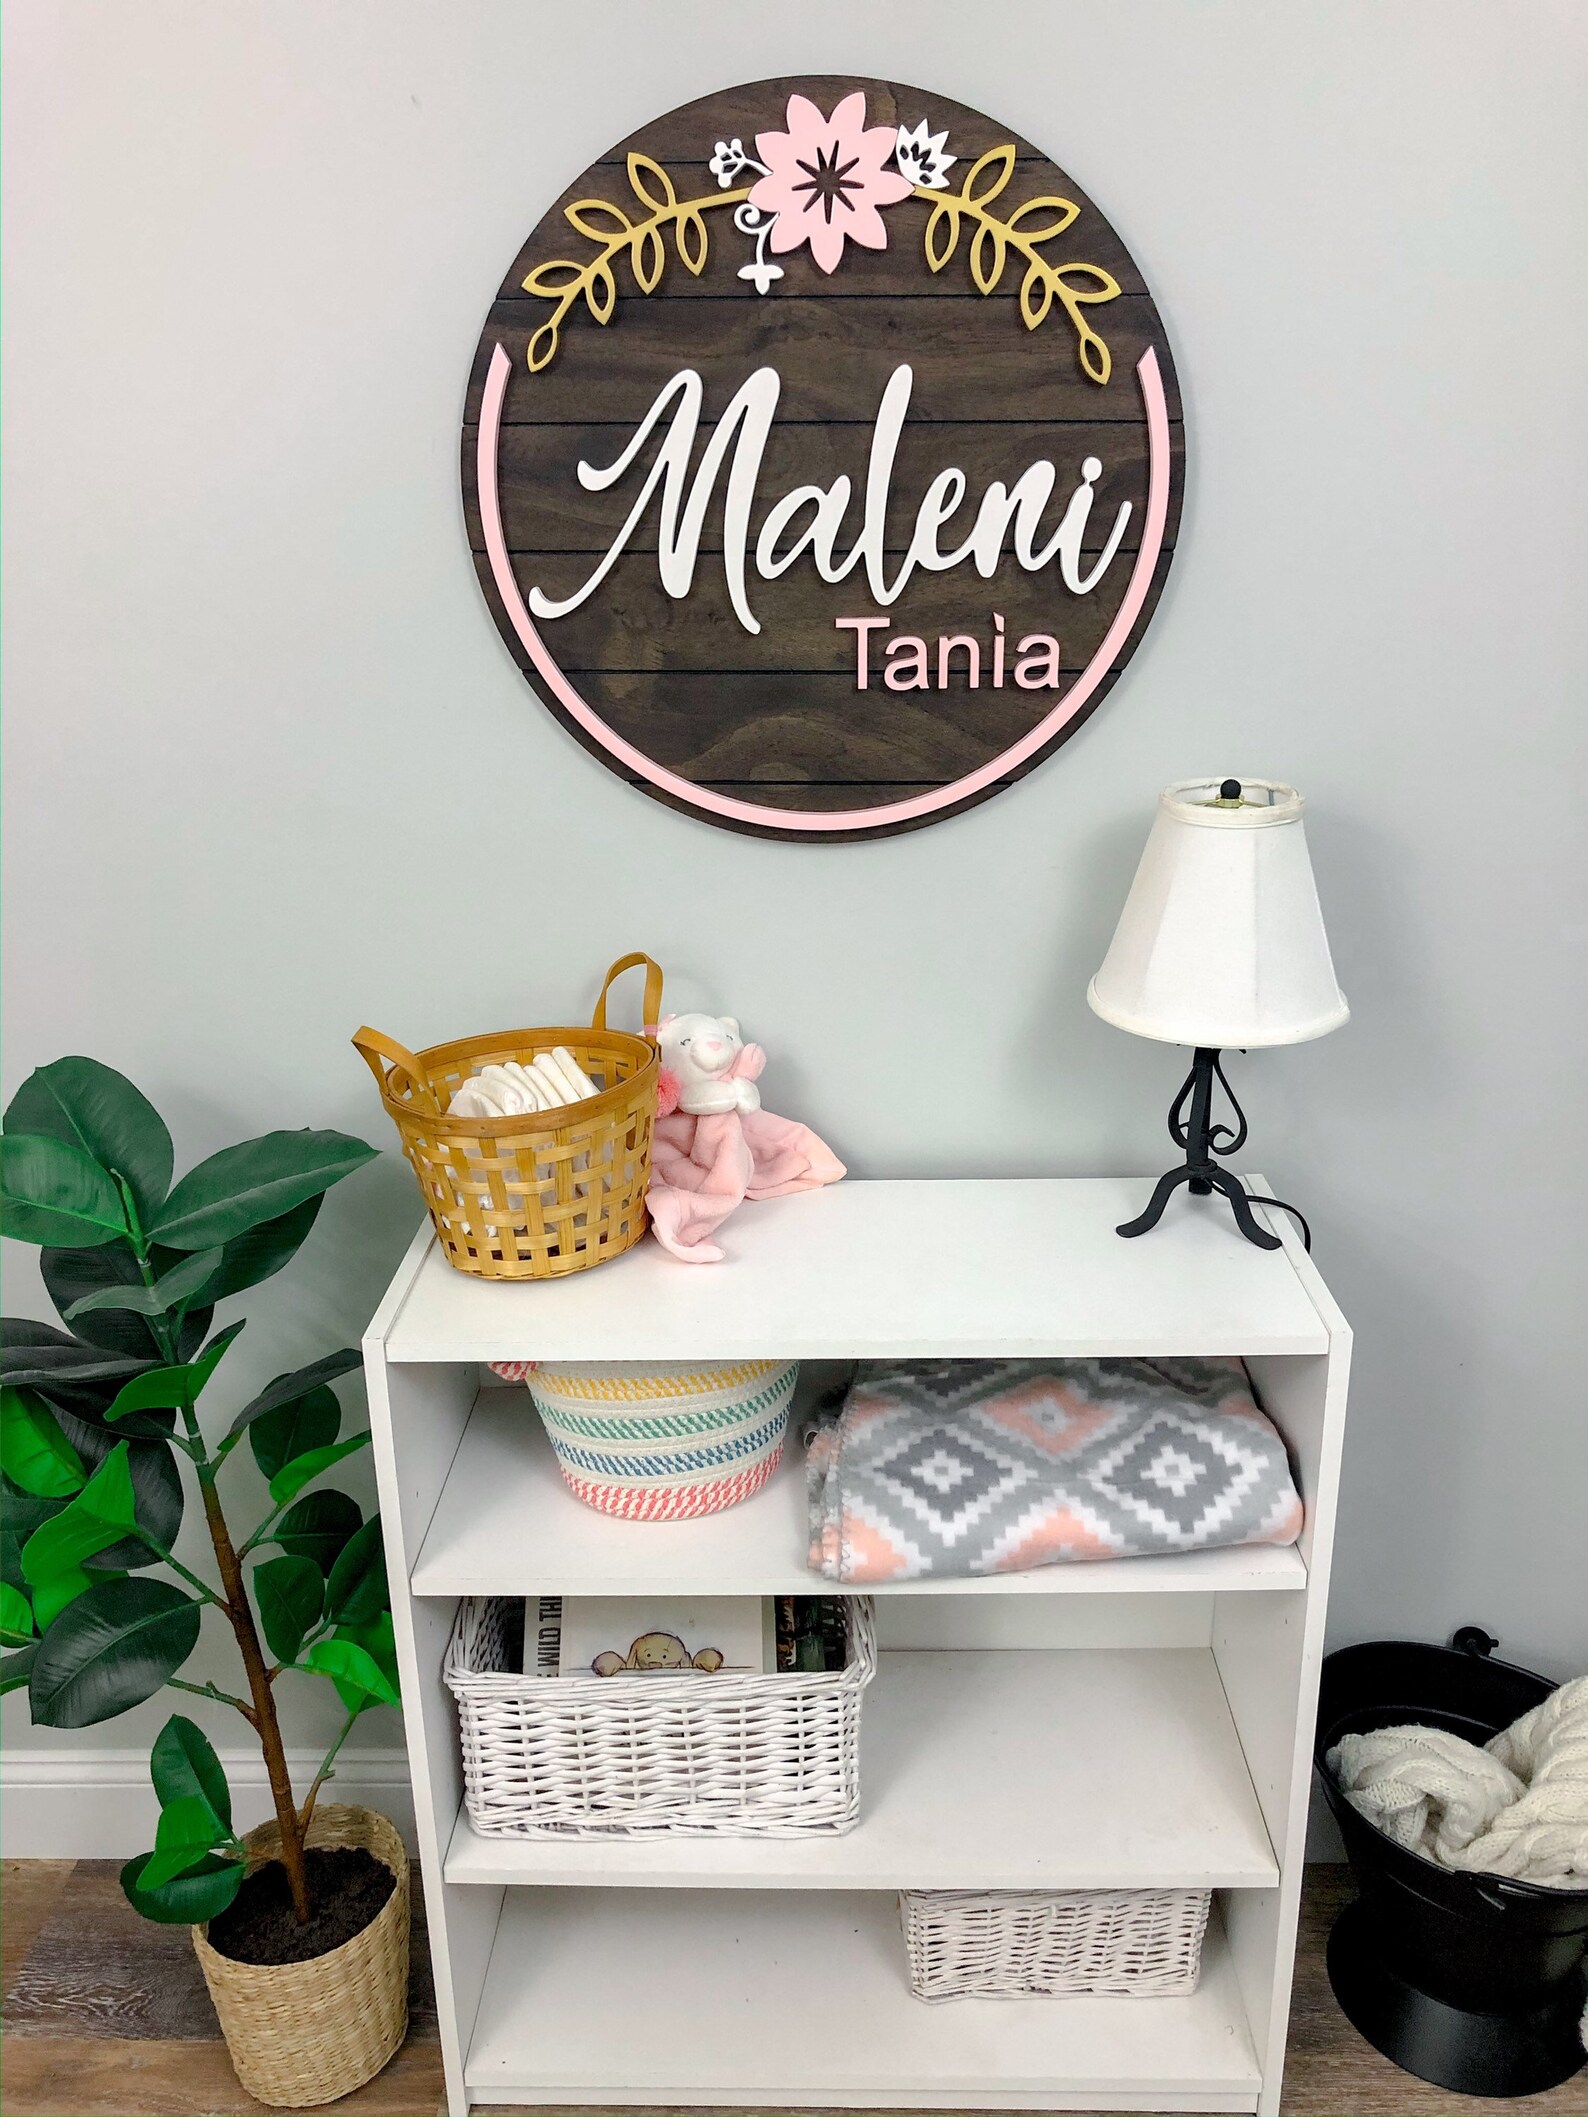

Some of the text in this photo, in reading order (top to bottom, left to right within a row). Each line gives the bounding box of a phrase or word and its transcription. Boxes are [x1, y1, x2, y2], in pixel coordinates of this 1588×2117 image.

[529, 364, 1132, 634] Maleni
[835, 612, 1060, 691] Tania
[538, 1627, 561, 1667] WILD
